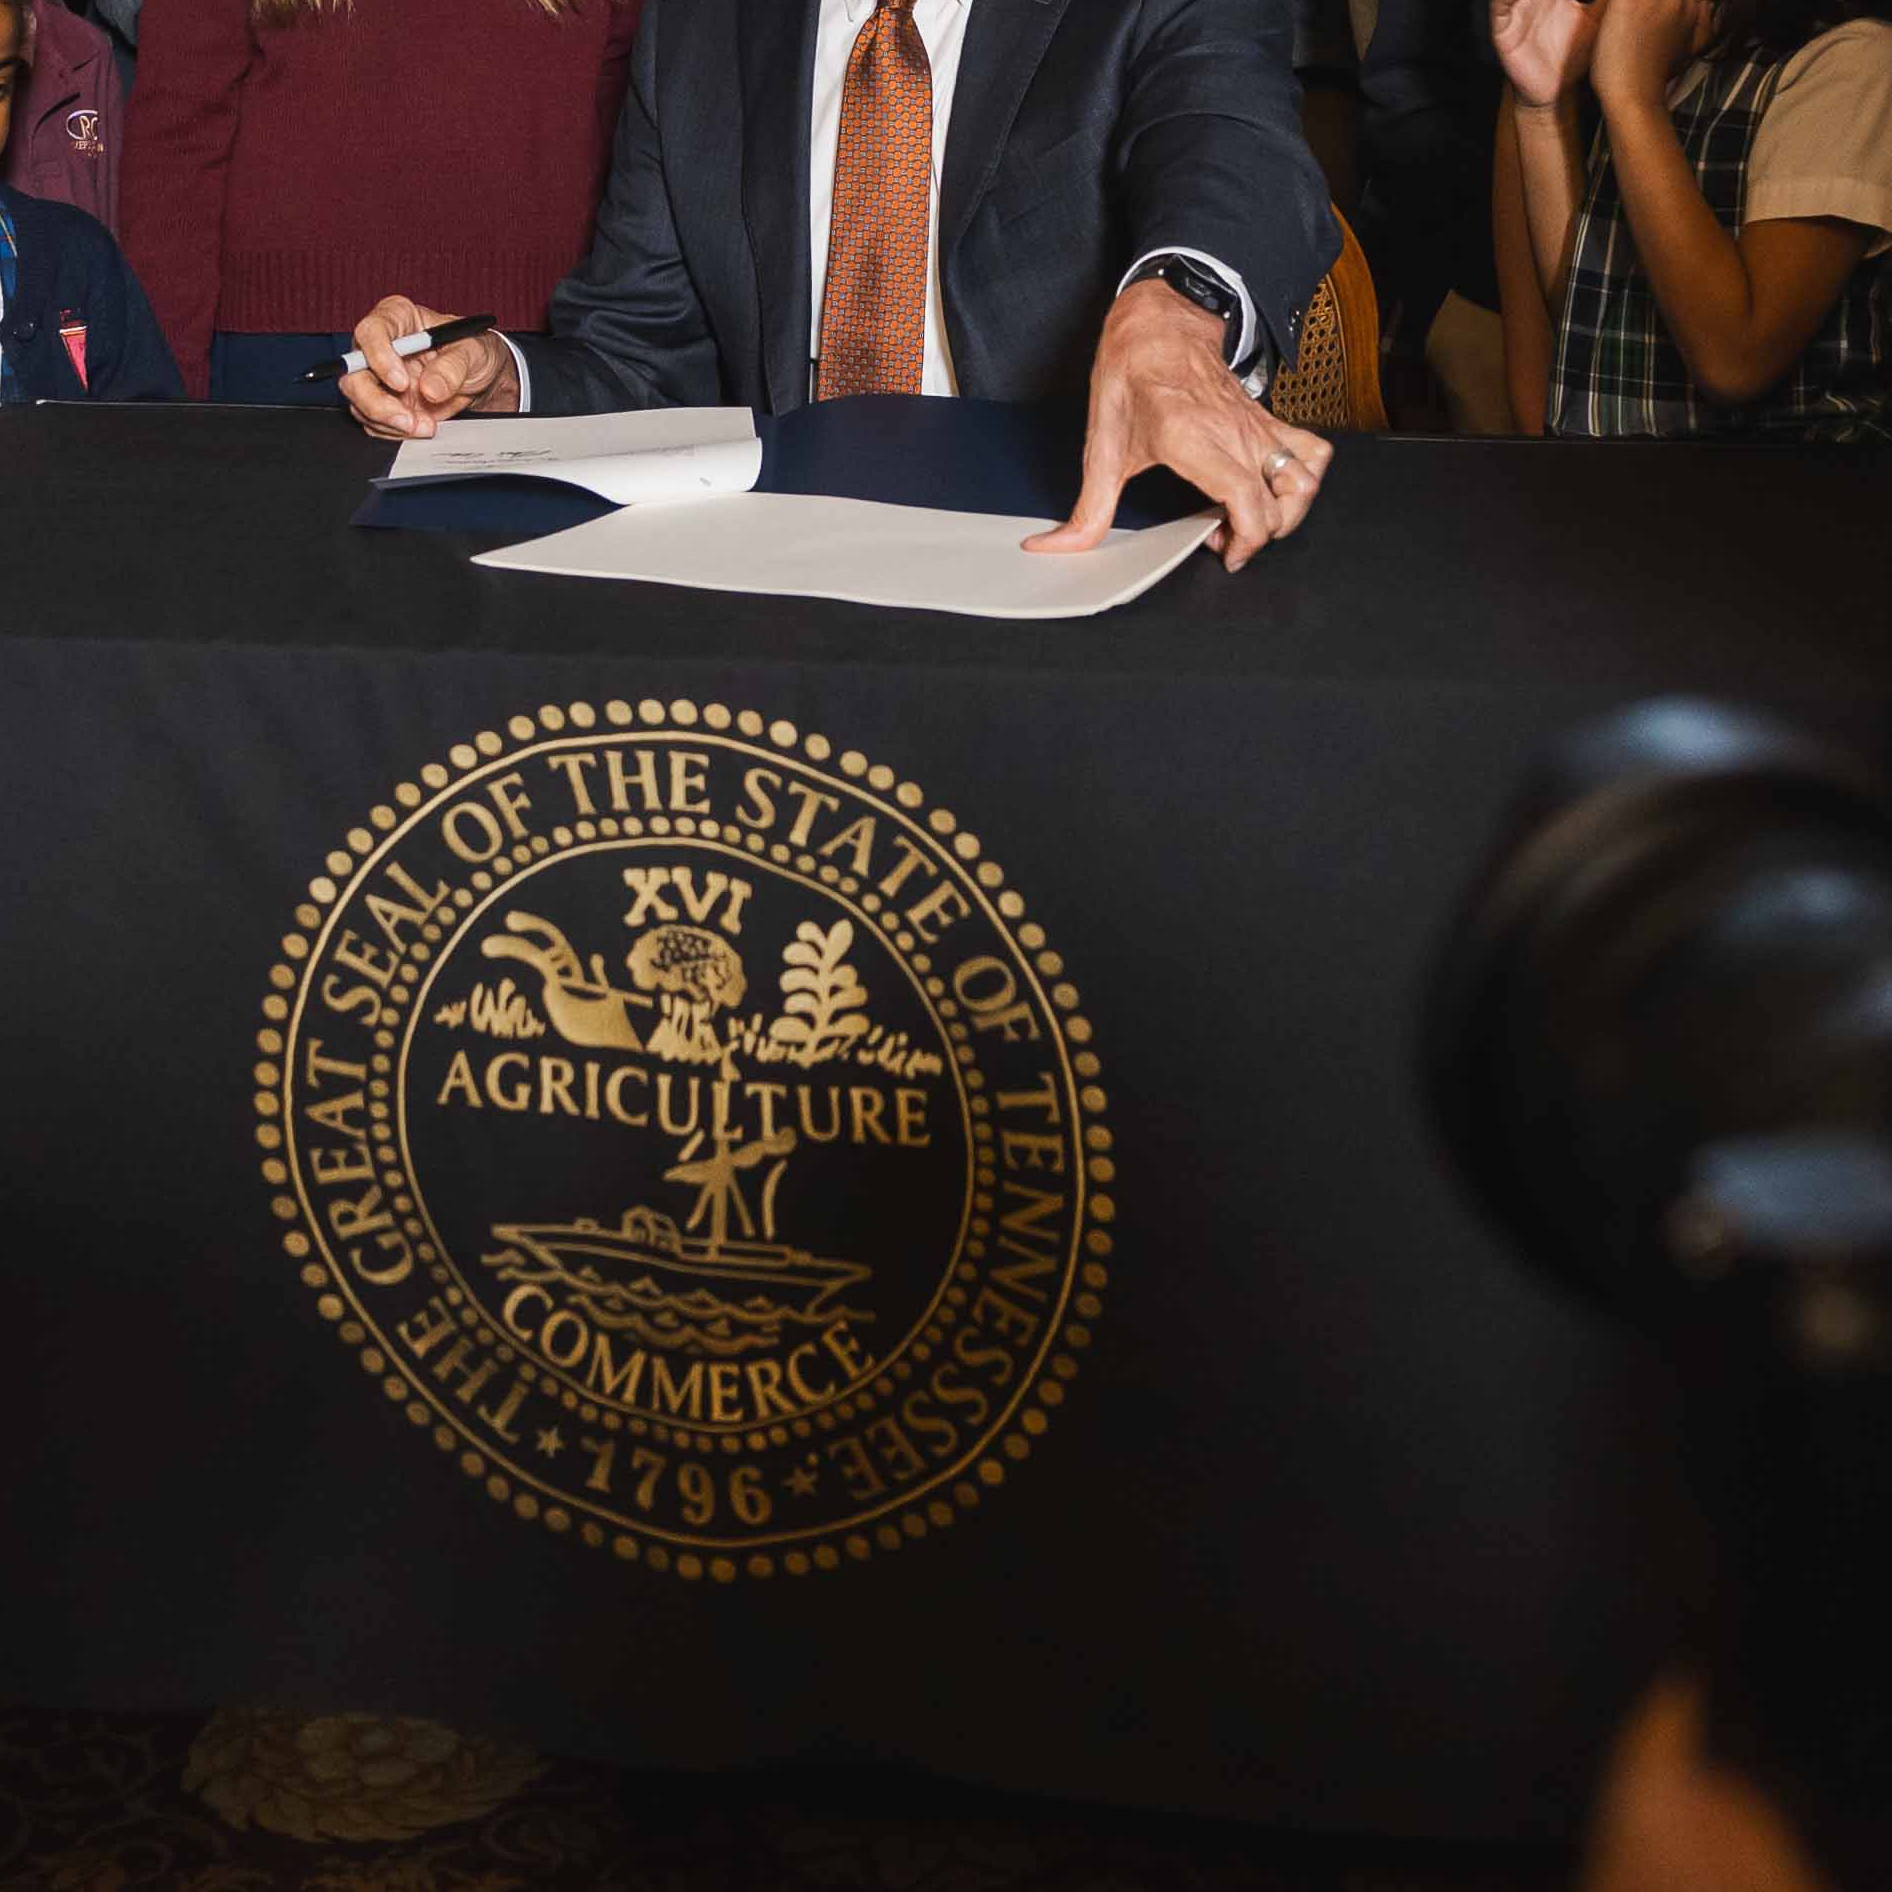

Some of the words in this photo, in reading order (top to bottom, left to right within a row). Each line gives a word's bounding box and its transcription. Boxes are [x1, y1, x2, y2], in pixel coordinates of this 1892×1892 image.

[442, 772, 533, 864] OF
[548, 749, 712, 814] THE
[621, 865, 753, 936] XVI
[736, 767, 972, 944] STATE
[320, 861, 449, 1025] SEAL
[953, 954, 1041, 1044] OF
[436, 1050, 932, 1148] AGRICULTURE
[307, 1039, 414, 1284] GREAT
[397, 1294, 528, 1442] THE
[502, 1284, 875, 1424] COMMERCE
[581, 1436, 773, 1526] 1796
